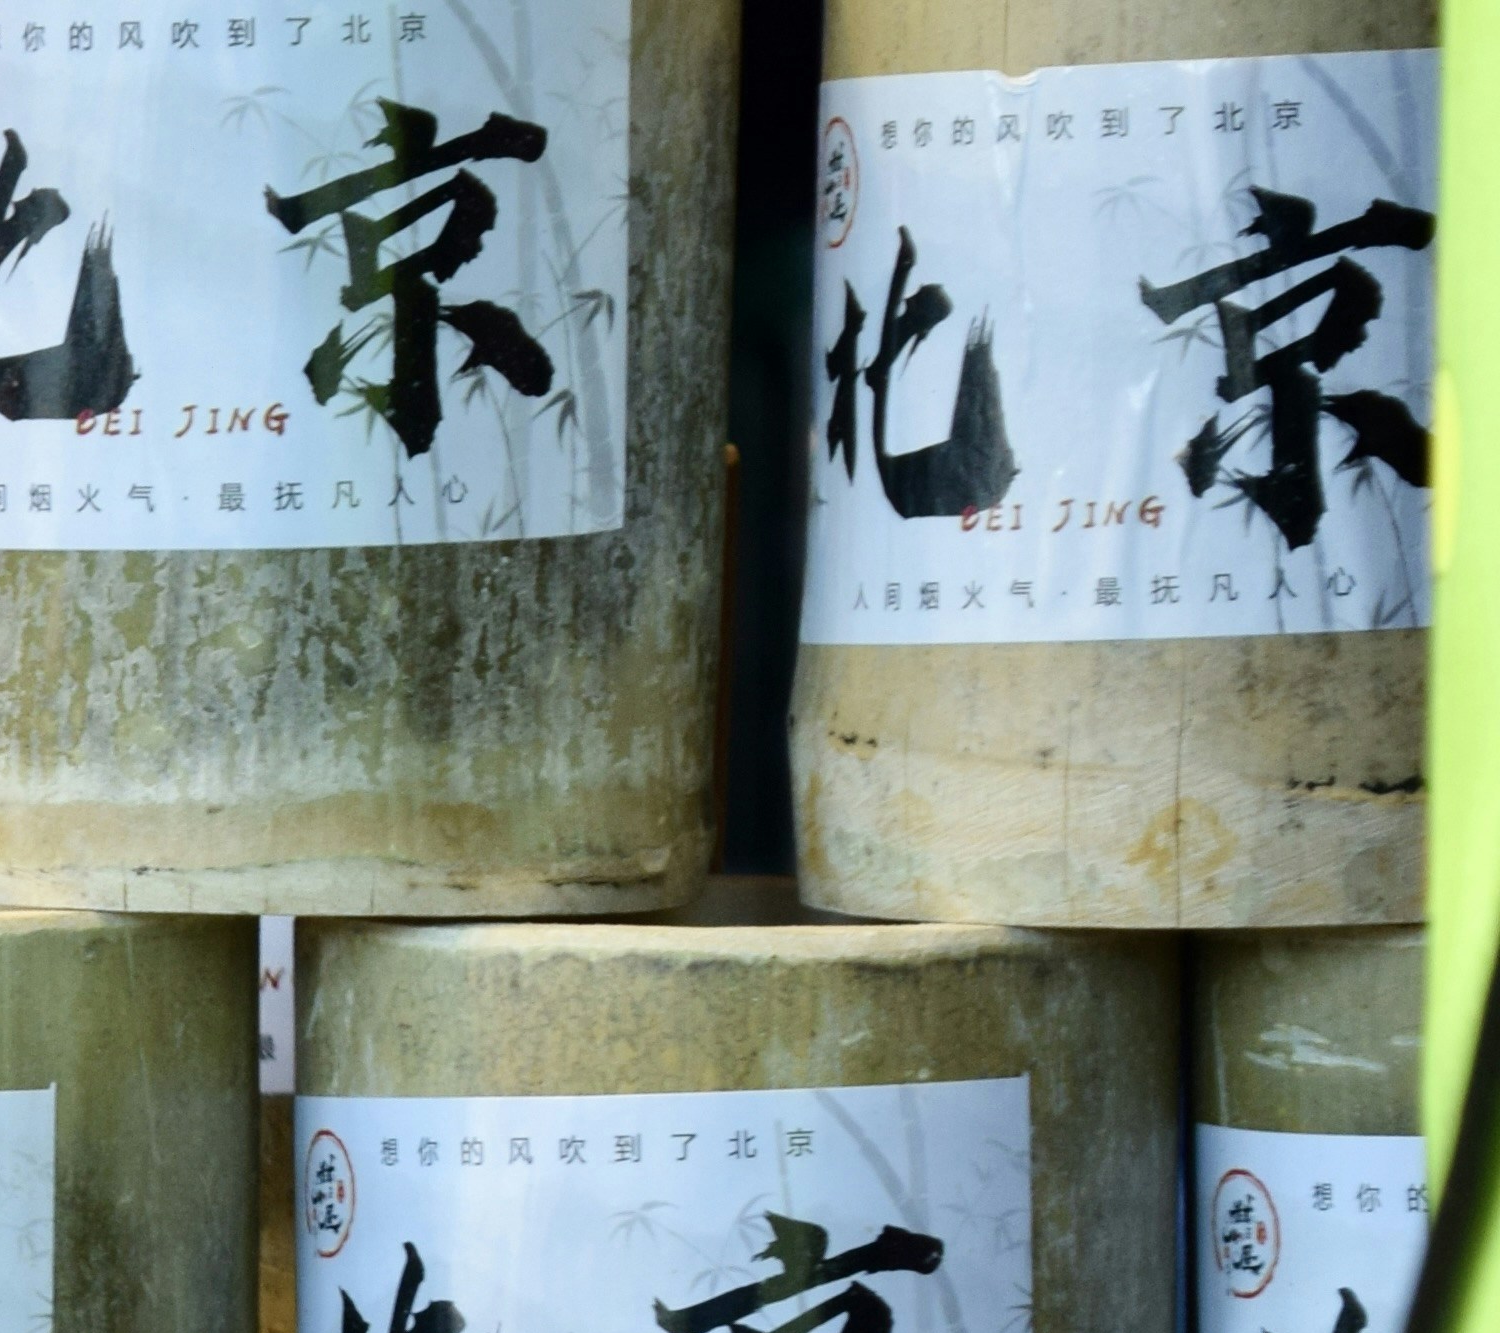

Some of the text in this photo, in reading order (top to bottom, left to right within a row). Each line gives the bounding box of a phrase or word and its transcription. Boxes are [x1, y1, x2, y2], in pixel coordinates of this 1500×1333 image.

[880, 99, 1305, 149] 想你的风吹到了北京
[825, 185, 1437, 552] 北京
[75, 405, 290, 438] BEI JING
[959, 498, 1165, 532] BEI JING
[380, 1128, 817, 1166] 想你的风吹到了北京
